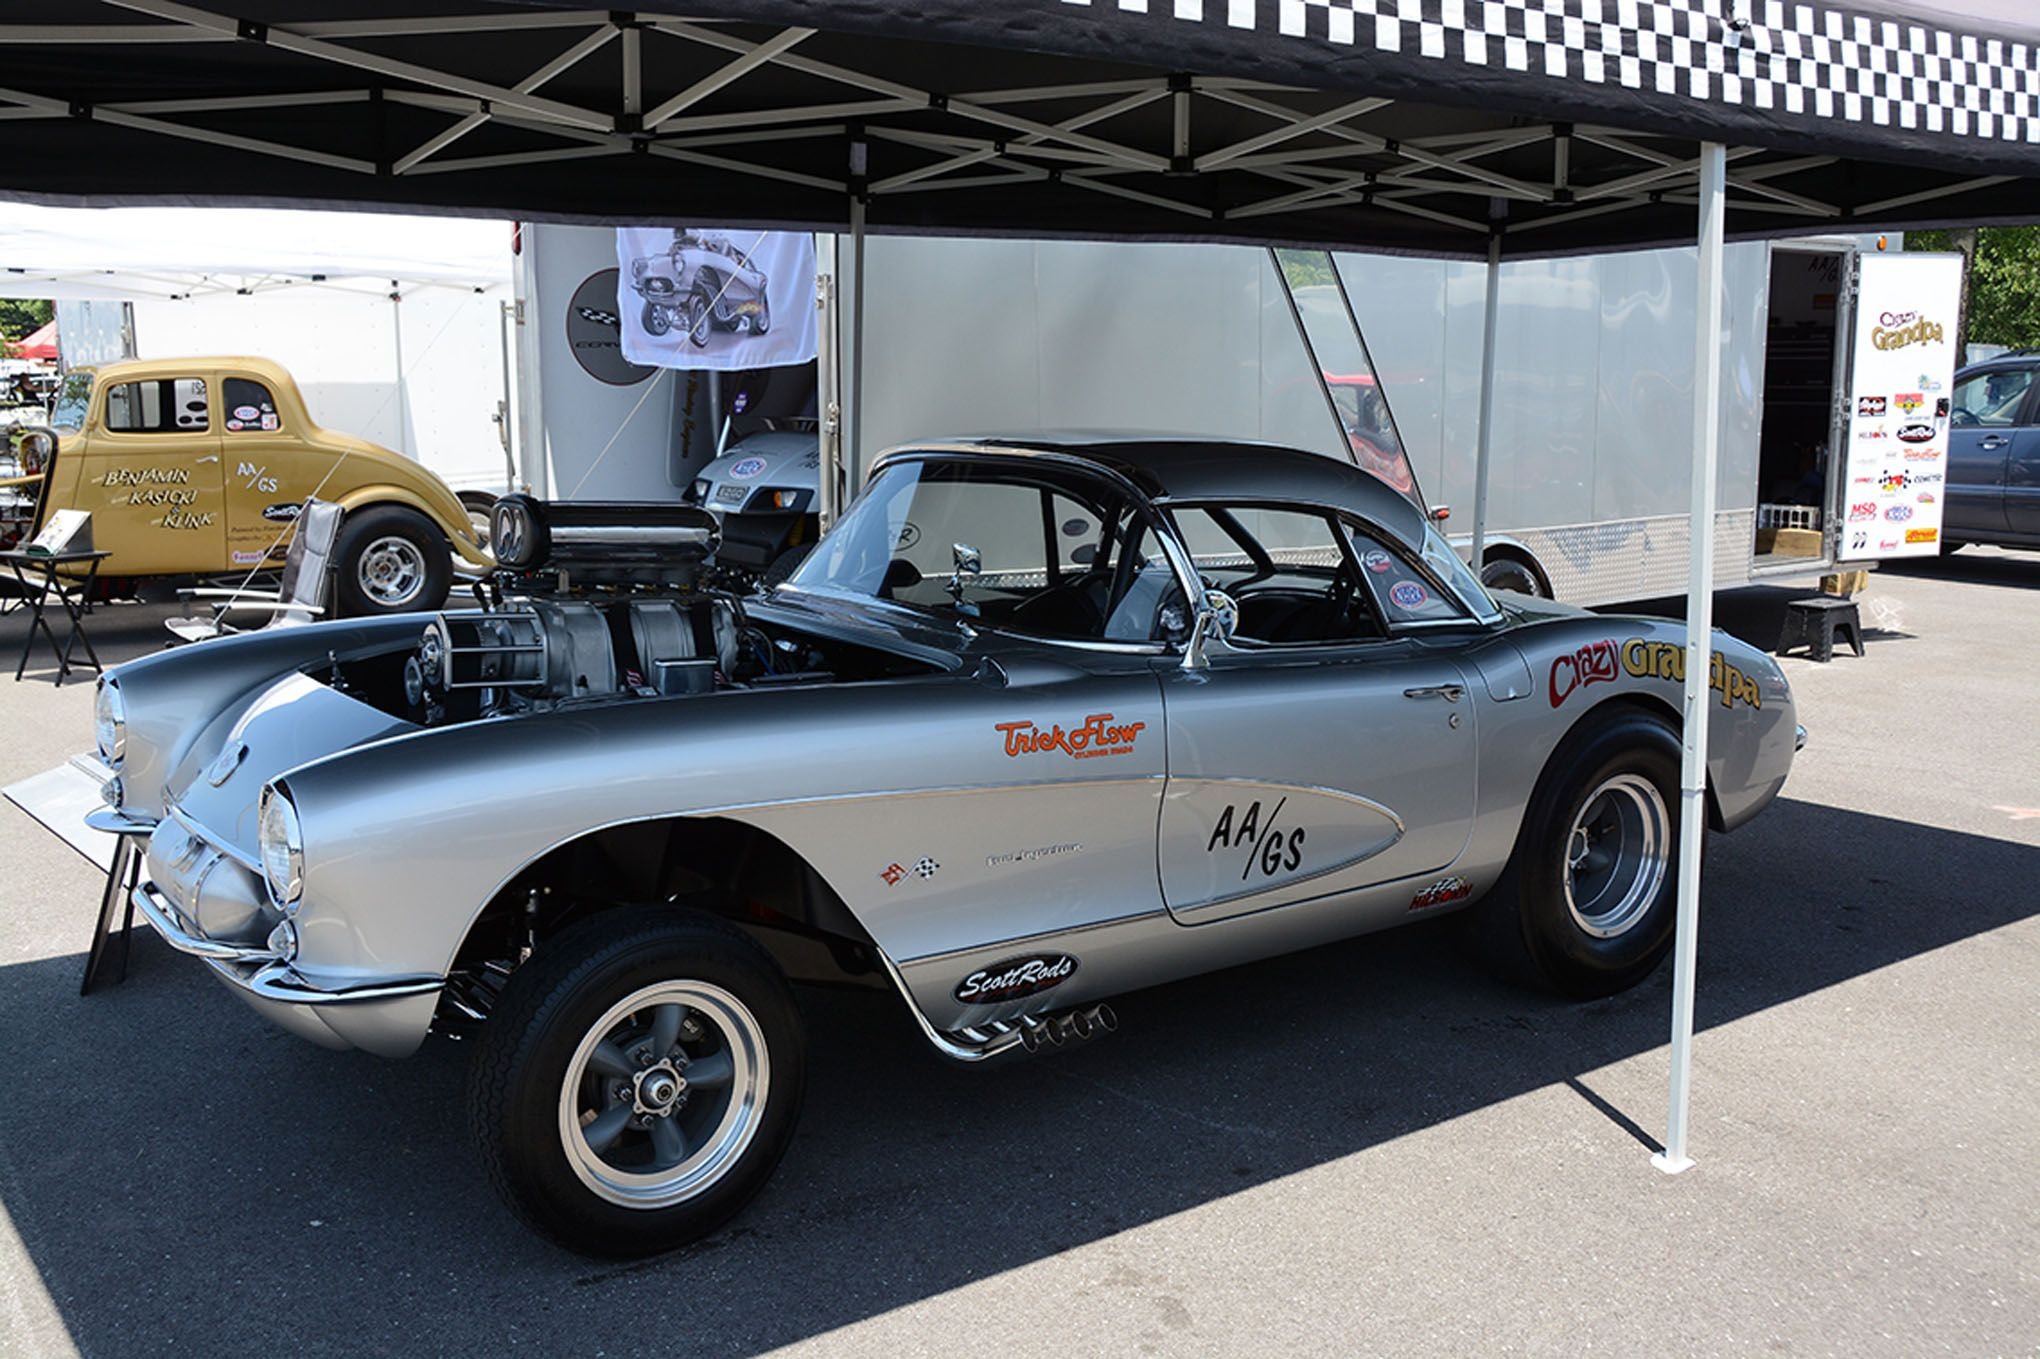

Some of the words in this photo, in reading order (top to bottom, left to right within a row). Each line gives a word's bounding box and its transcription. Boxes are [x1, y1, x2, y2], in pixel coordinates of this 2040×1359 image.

[1871, 315, 1944, 351] Grandpa
[103, 467, 190, 487] BENJAMIN
[236, 462, 279, 494] AA/GS
[128, 488, 198, 506] KASICKI
[1548, 639, 1620, 709] Crazy
[1621, 637, 1761, 710] Gradpa
[995, 721, 1073, 757] Trick
[1069, 713, 1146, 750] Flow
[1207, 796, 1305, 880] AA/GS
[959, 955, 1072, 998] ScottRods
